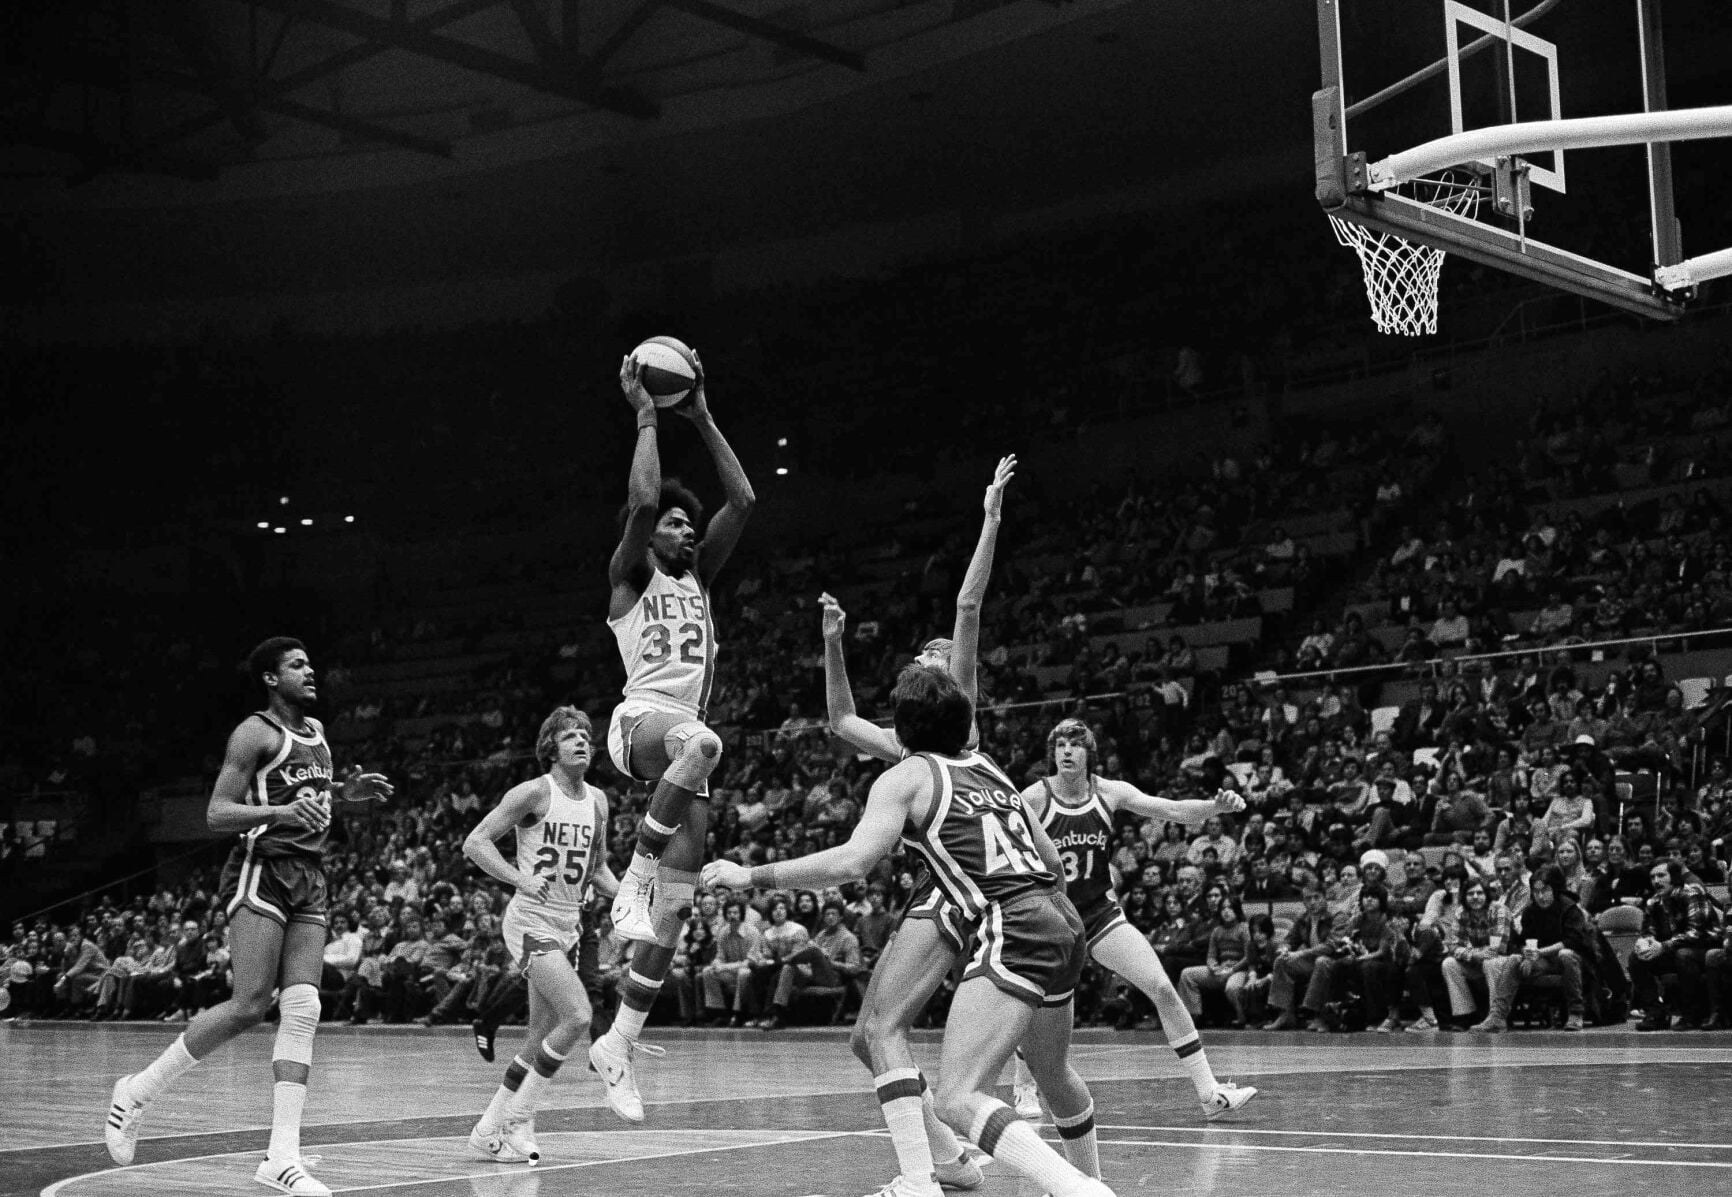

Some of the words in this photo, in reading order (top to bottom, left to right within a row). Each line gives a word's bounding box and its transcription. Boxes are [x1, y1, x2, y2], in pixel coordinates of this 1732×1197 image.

[643, 593, 704, 622] NETS
[641, 623, 704, 664] 32
[954, 789, 1021, 815] Joyce
[543, 822, 591, 848] NETS
[981, 810, 1047, 876] 43
[533, 846, 586, 885] 25
[1060, 849, 1094, 882] 31
